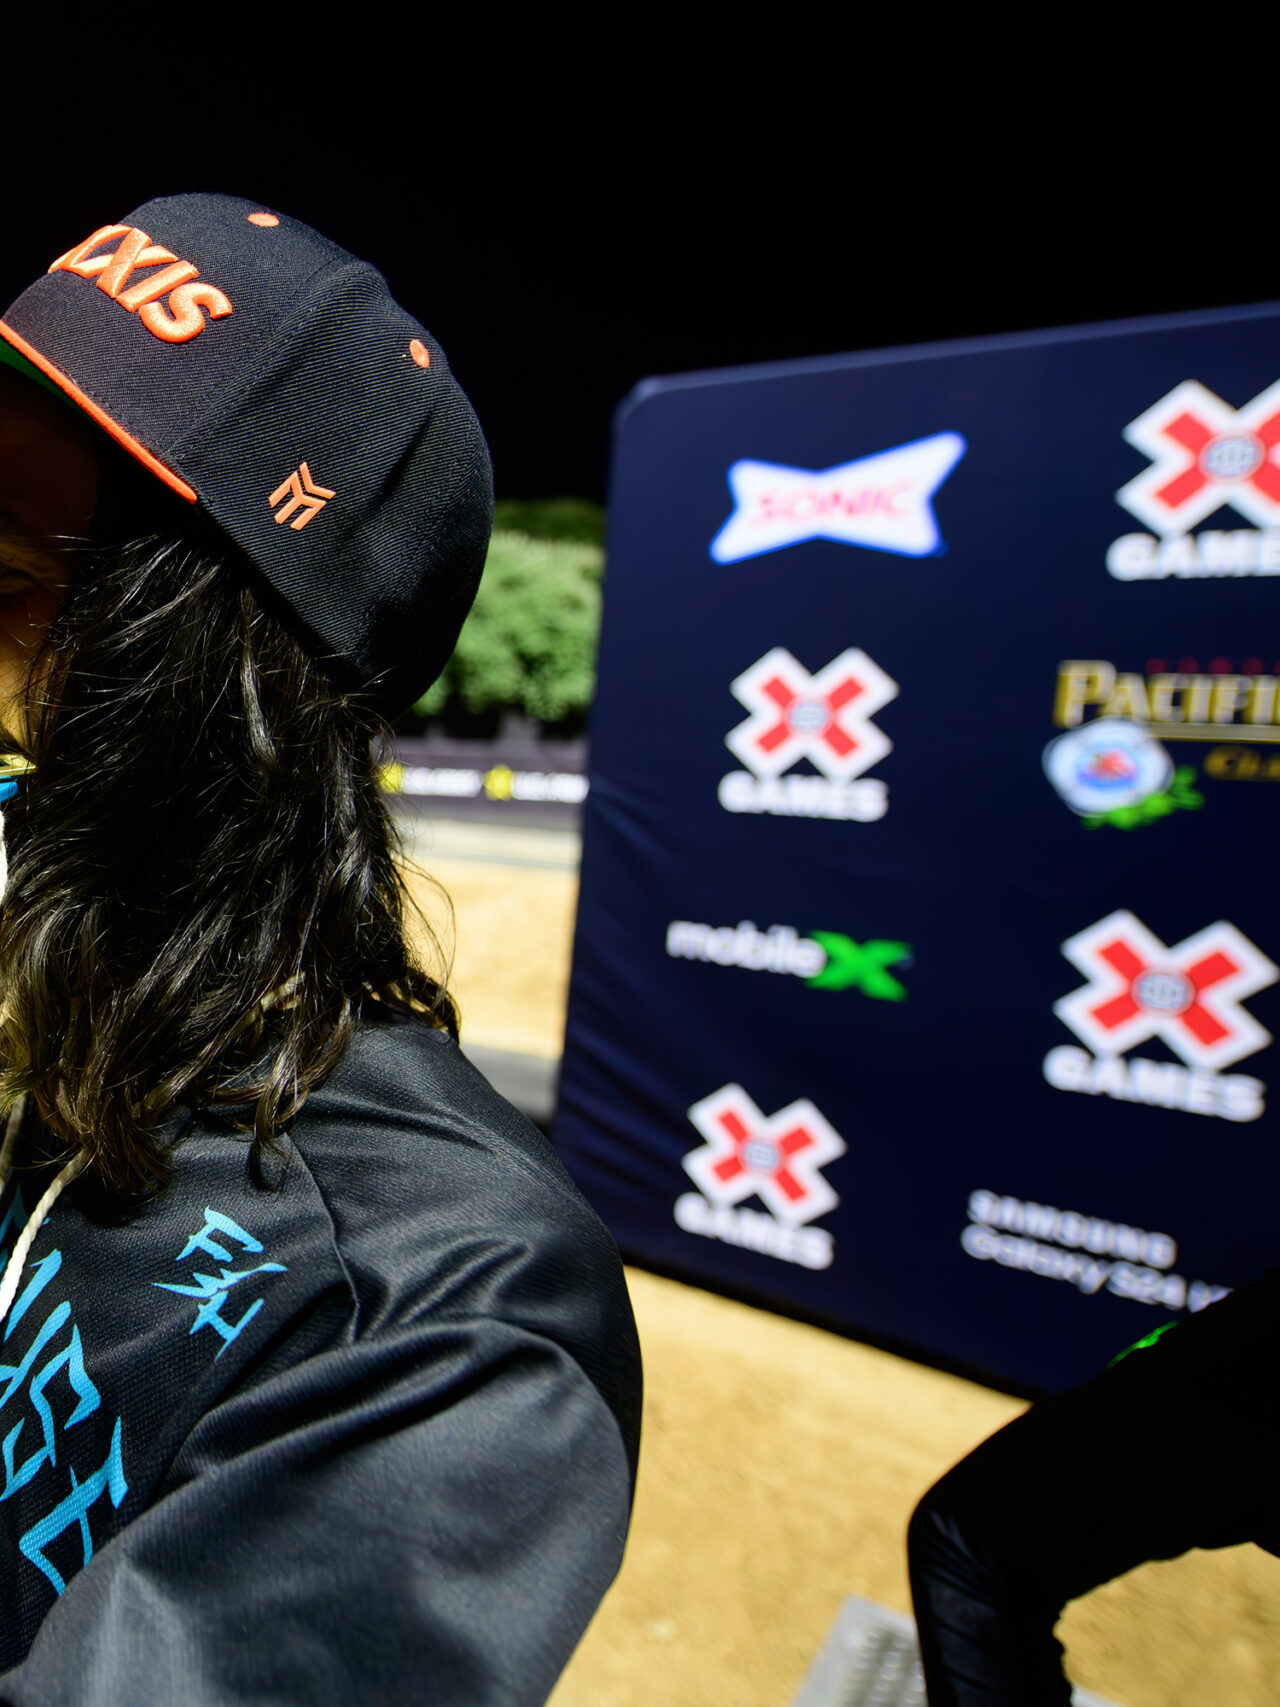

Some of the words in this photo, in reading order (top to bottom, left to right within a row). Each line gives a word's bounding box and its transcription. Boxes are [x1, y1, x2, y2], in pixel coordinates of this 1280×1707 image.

[1105, 527, 1280, 582] GAME
[1042, 1044, 1267, 1123] GAMES
[968, 1188, 1177, 1270] SAMSUNG
